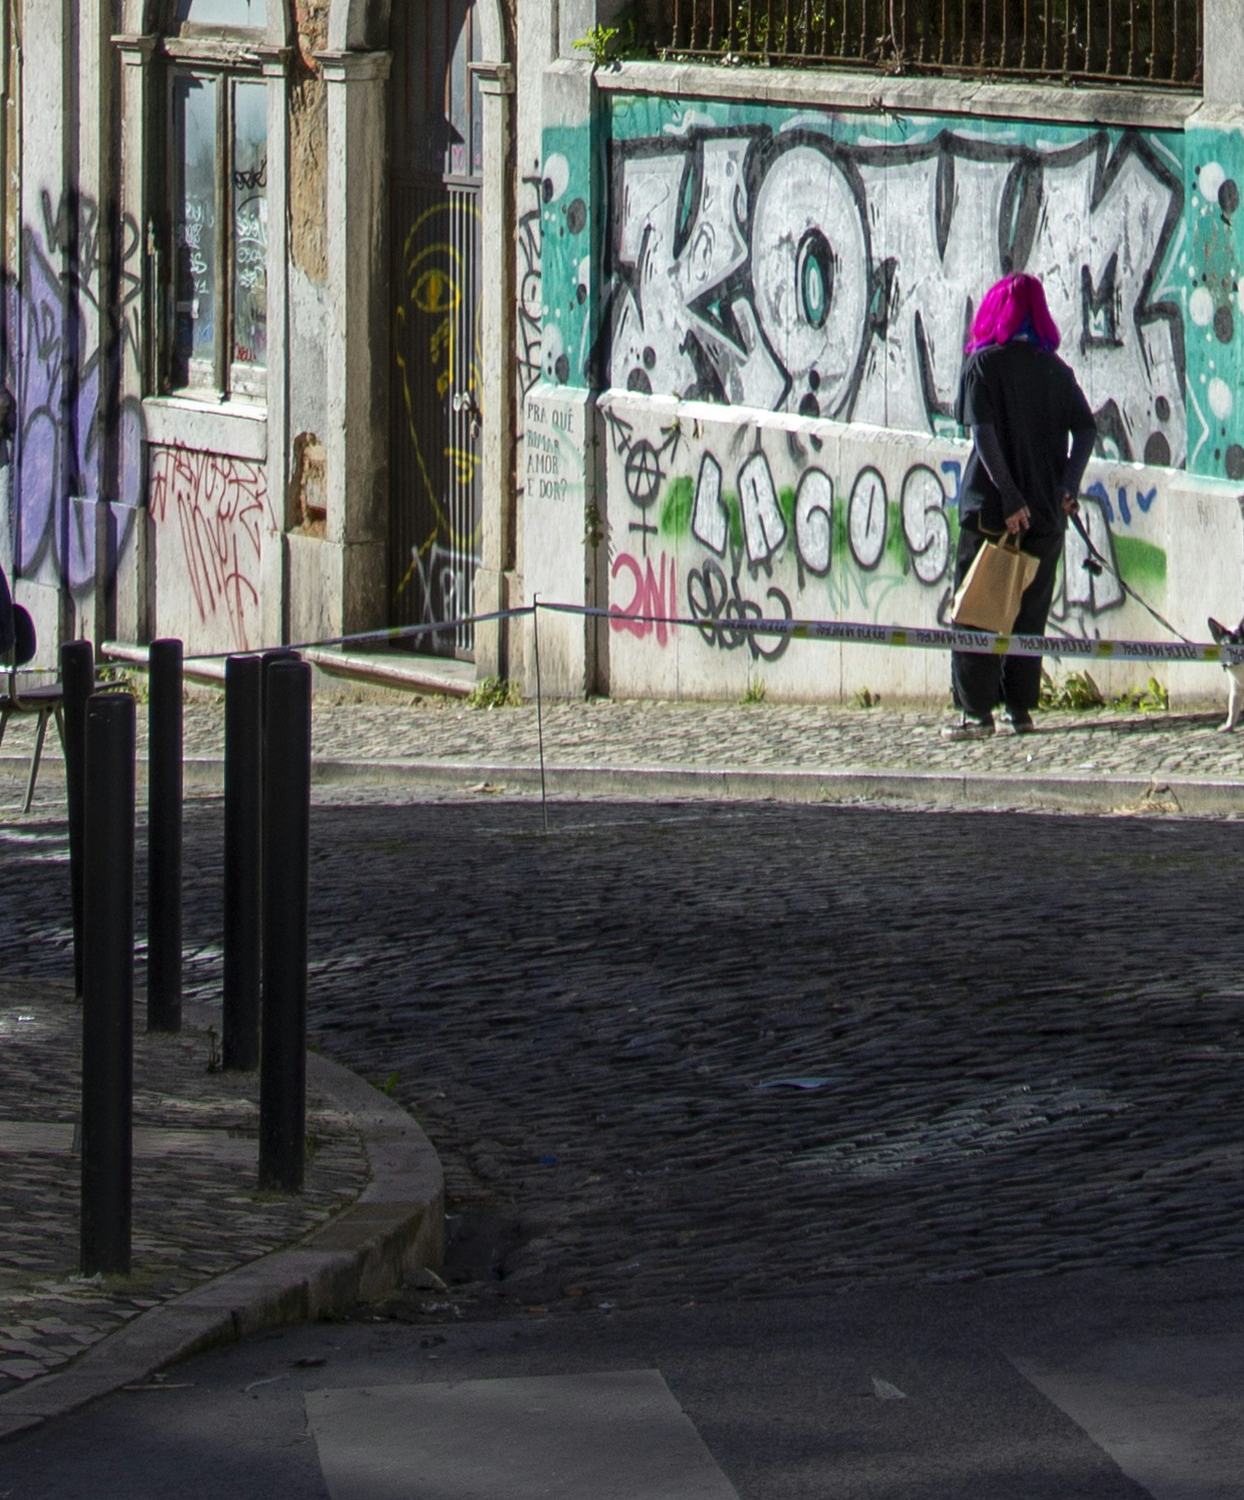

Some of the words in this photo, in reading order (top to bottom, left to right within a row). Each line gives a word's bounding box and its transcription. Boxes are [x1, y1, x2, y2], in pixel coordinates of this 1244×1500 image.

[527, 403, 547, 423] PRA
[527, 454, 558, 475] AMOR
[528, 478, 535, 497] E
[539, 478, 567, 503] DOR?
[1018, 636, 1060, 652] MUNICIPAL
[1119, 642, 1164, 657] MUNICIPAL
